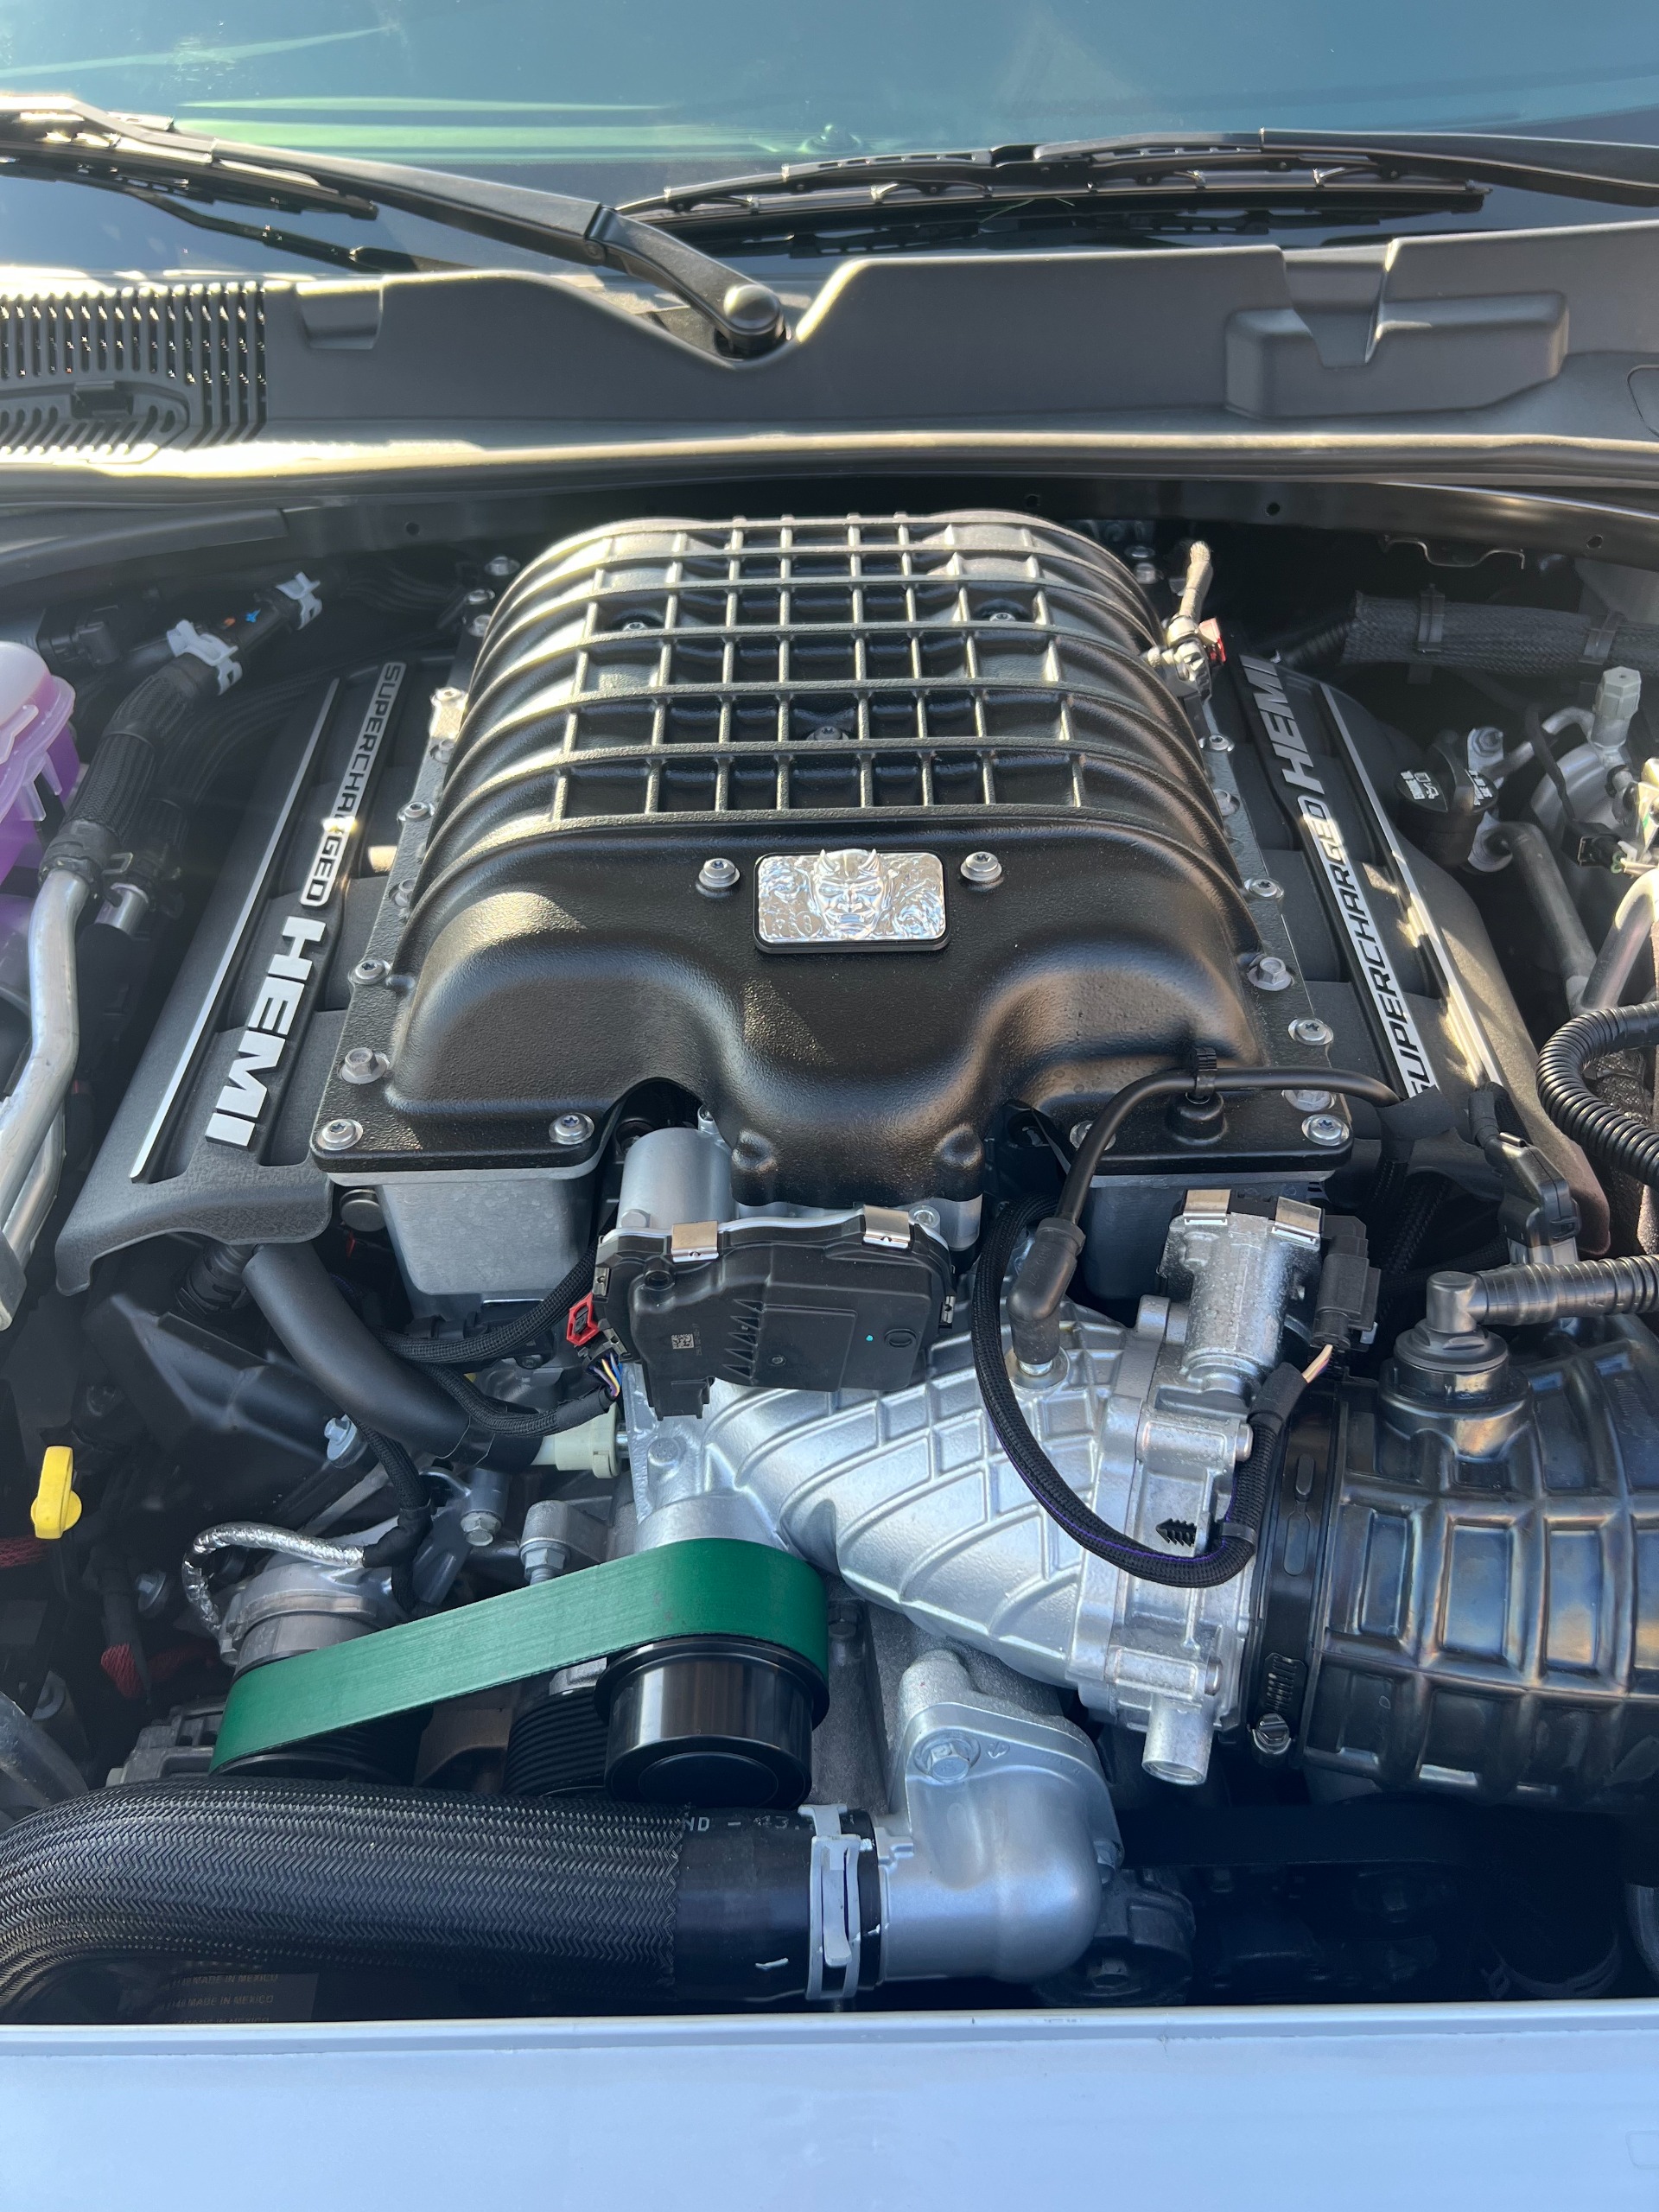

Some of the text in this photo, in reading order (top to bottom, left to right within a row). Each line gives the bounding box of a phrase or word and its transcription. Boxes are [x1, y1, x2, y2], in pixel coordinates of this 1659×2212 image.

[1239, 654, 1325, 795] HEMI
[205, 916, 327, 1148] HEMI
[188, 1996, 217, 2006] MADE
[219, 1995, 232, 2005] IN
[233, 1994, 274, 2005] MEXICO
